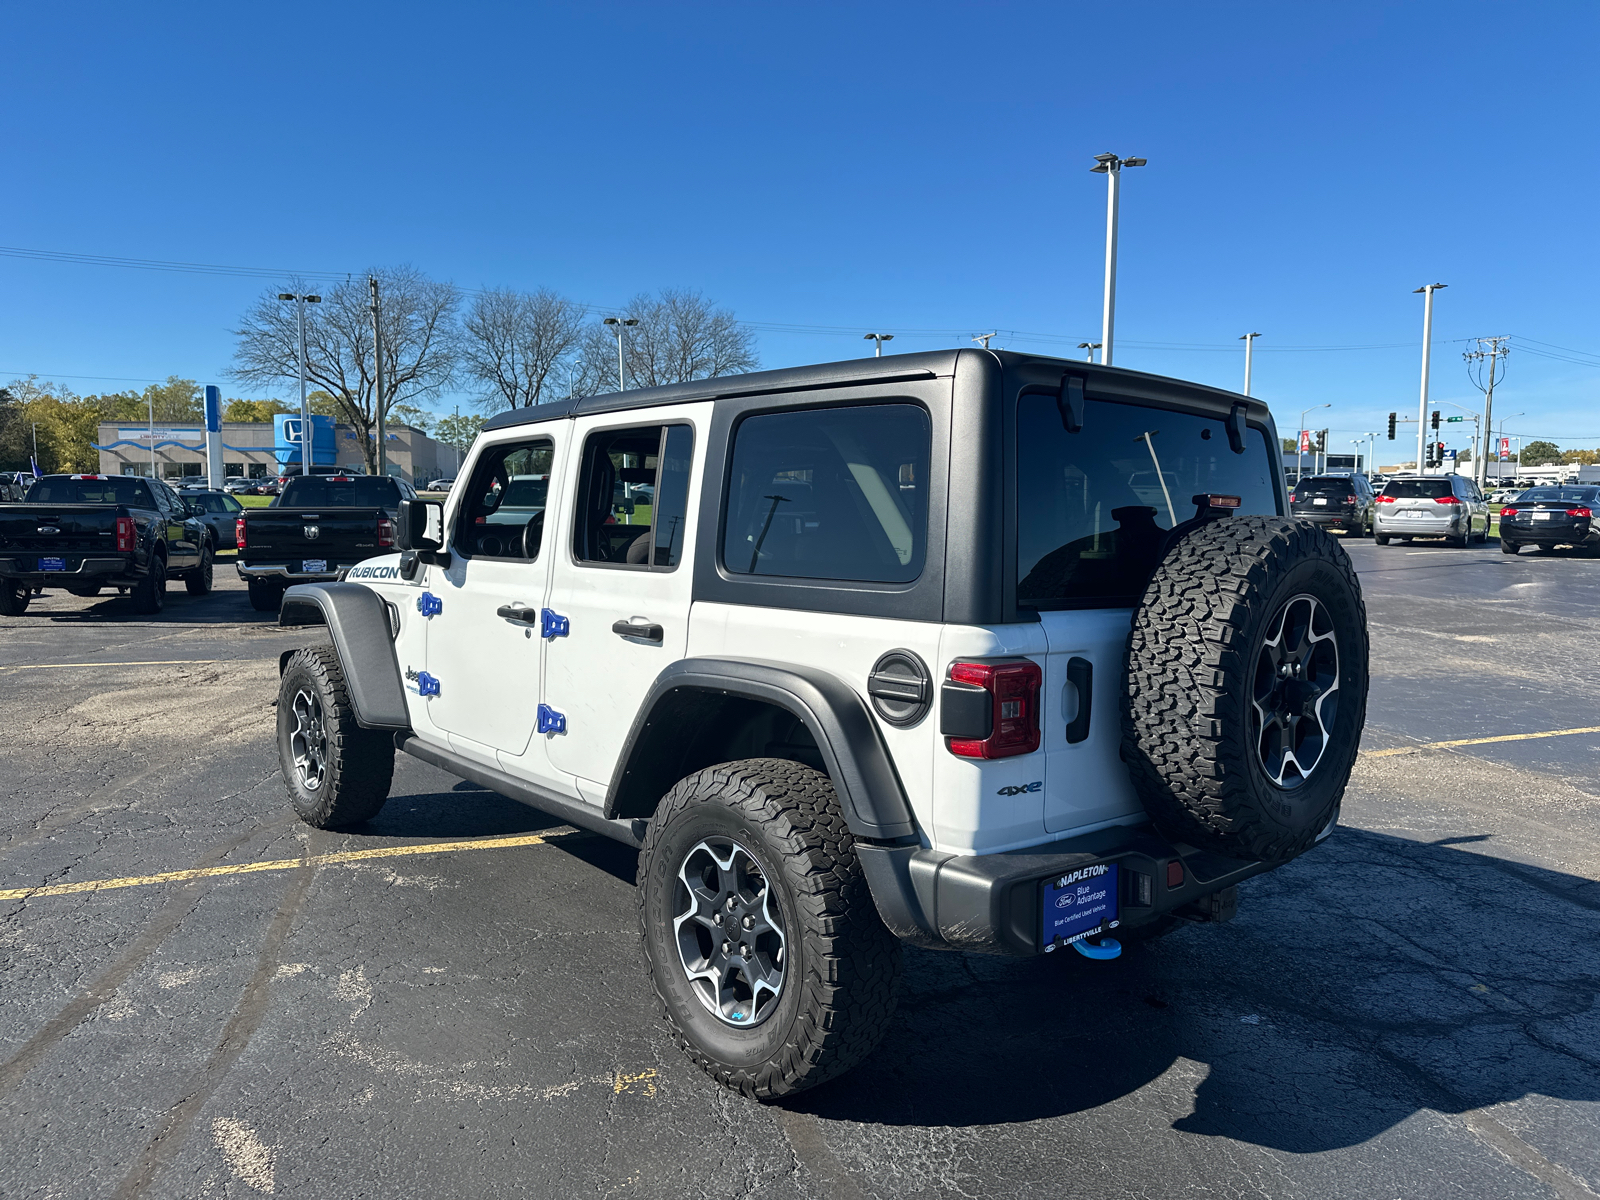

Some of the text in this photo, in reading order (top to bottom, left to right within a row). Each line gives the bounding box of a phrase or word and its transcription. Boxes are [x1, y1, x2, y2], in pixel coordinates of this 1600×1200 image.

[346, 432, 399, 441] HNA
[349, 566, 401, 579] RUBICON
[405, 665, 420, 682] Jee
[996, 781, 1042, 796] 4xe
[1060, 865, 1106, 887] NAPLETON
[1077, 886, 1090, 896] Blue
[1077, 890, 1106, 905] Advantage
[1054, 904, 1106, 927] Blue Certified Used Vehicle
[1063, 926, 1102, 946] LIBERTYVILLE
